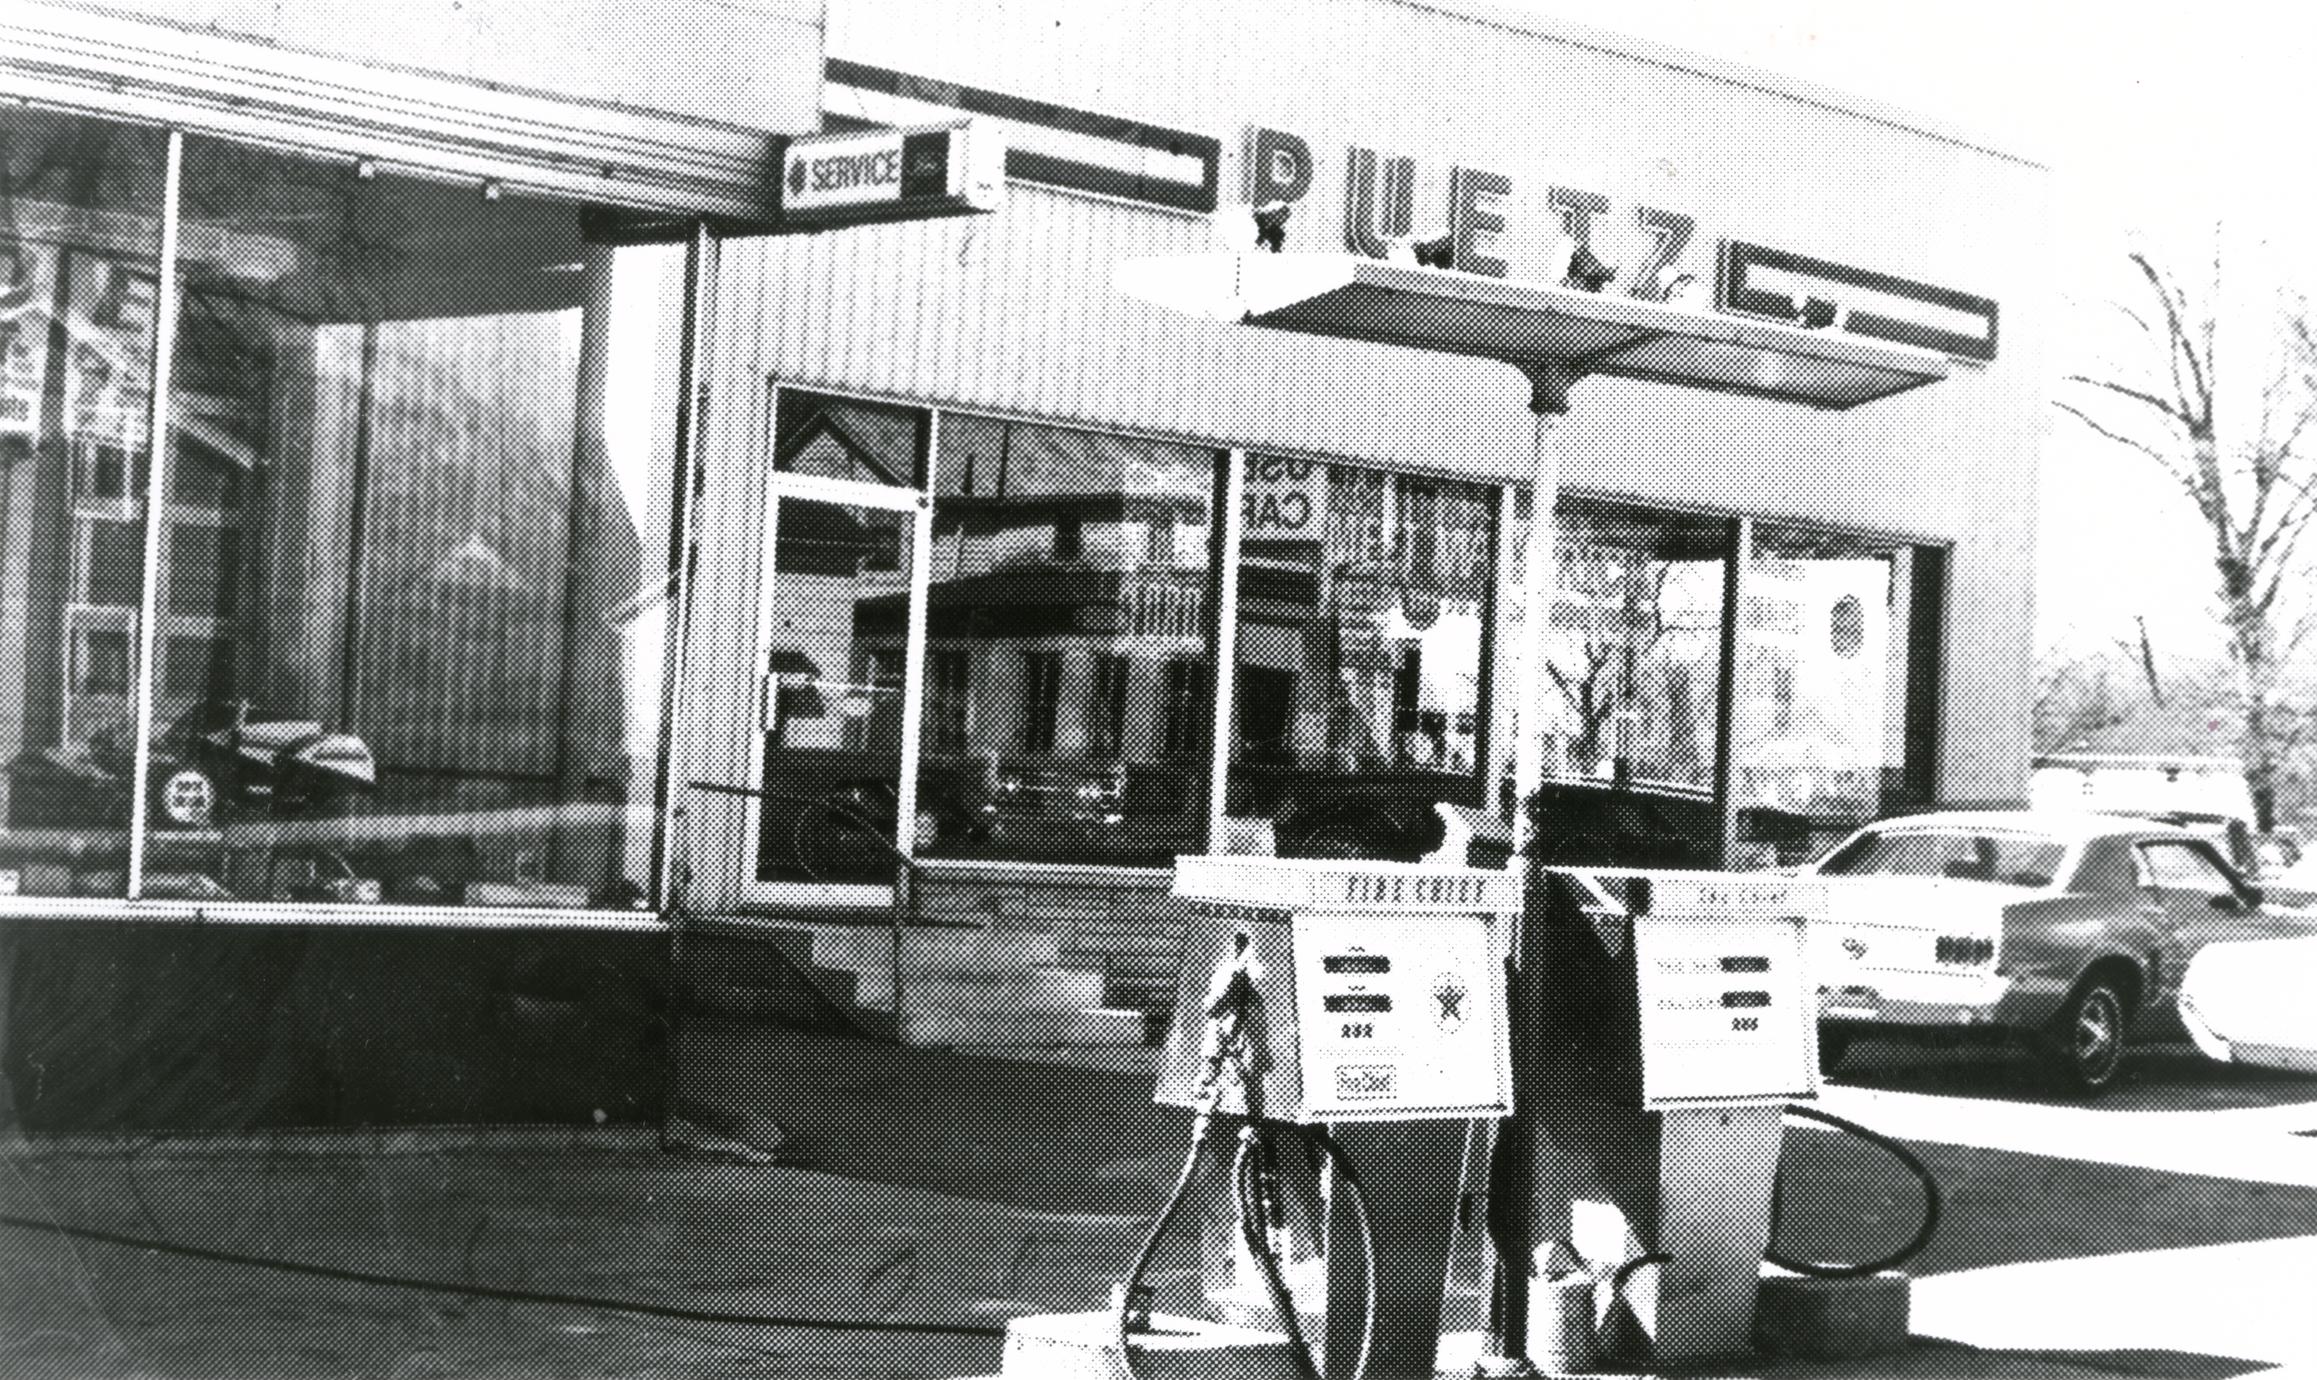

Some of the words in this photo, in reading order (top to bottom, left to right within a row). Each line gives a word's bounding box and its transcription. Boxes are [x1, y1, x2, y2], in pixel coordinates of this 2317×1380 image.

[811, 151, 900, 191] SERVICE
[1239, 124, 1696, 304] PUETZ
[1347, 876, 1403, 903] FIRE
[1416, 877, 1486, 904] CHIEF
